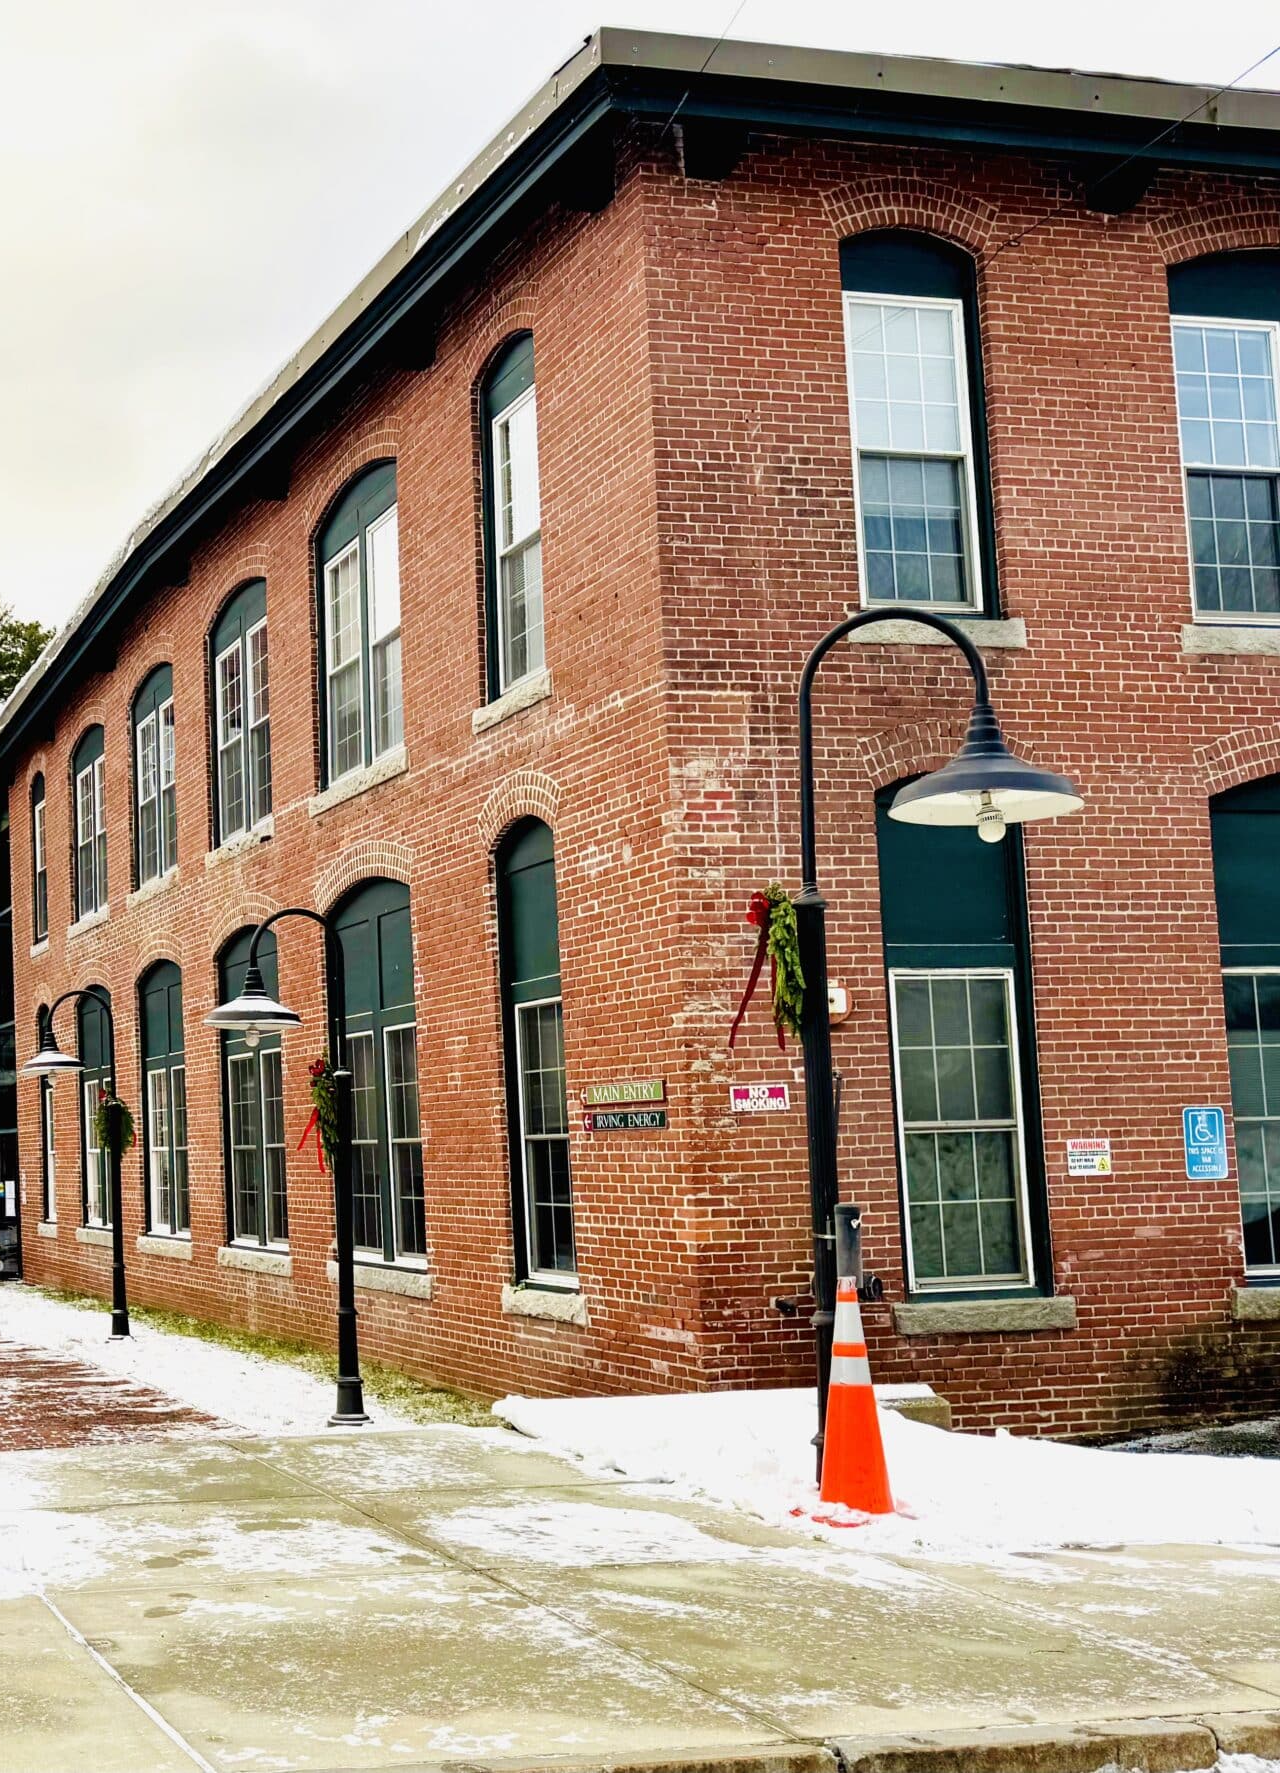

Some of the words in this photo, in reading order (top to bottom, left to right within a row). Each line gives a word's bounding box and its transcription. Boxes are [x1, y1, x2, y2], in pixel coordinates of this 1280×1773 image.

[593, 1085, 620, 1102] MAIN
[623, 1083, 656, 1100] ENTRY
[748, 1087, 770, 1098] NO
[735, 1097, 786, 1110] SMOKING
[596, 1114, 625, 1129] IRVING
[628, 1112, 661, 1128] ENERGY
[1070, 1140, 1106, 1150] WARNING
[1201, 1147, 1217, 1155] SPACE
[1192, 1164, 1224, 1172] ACCESSIBLE
